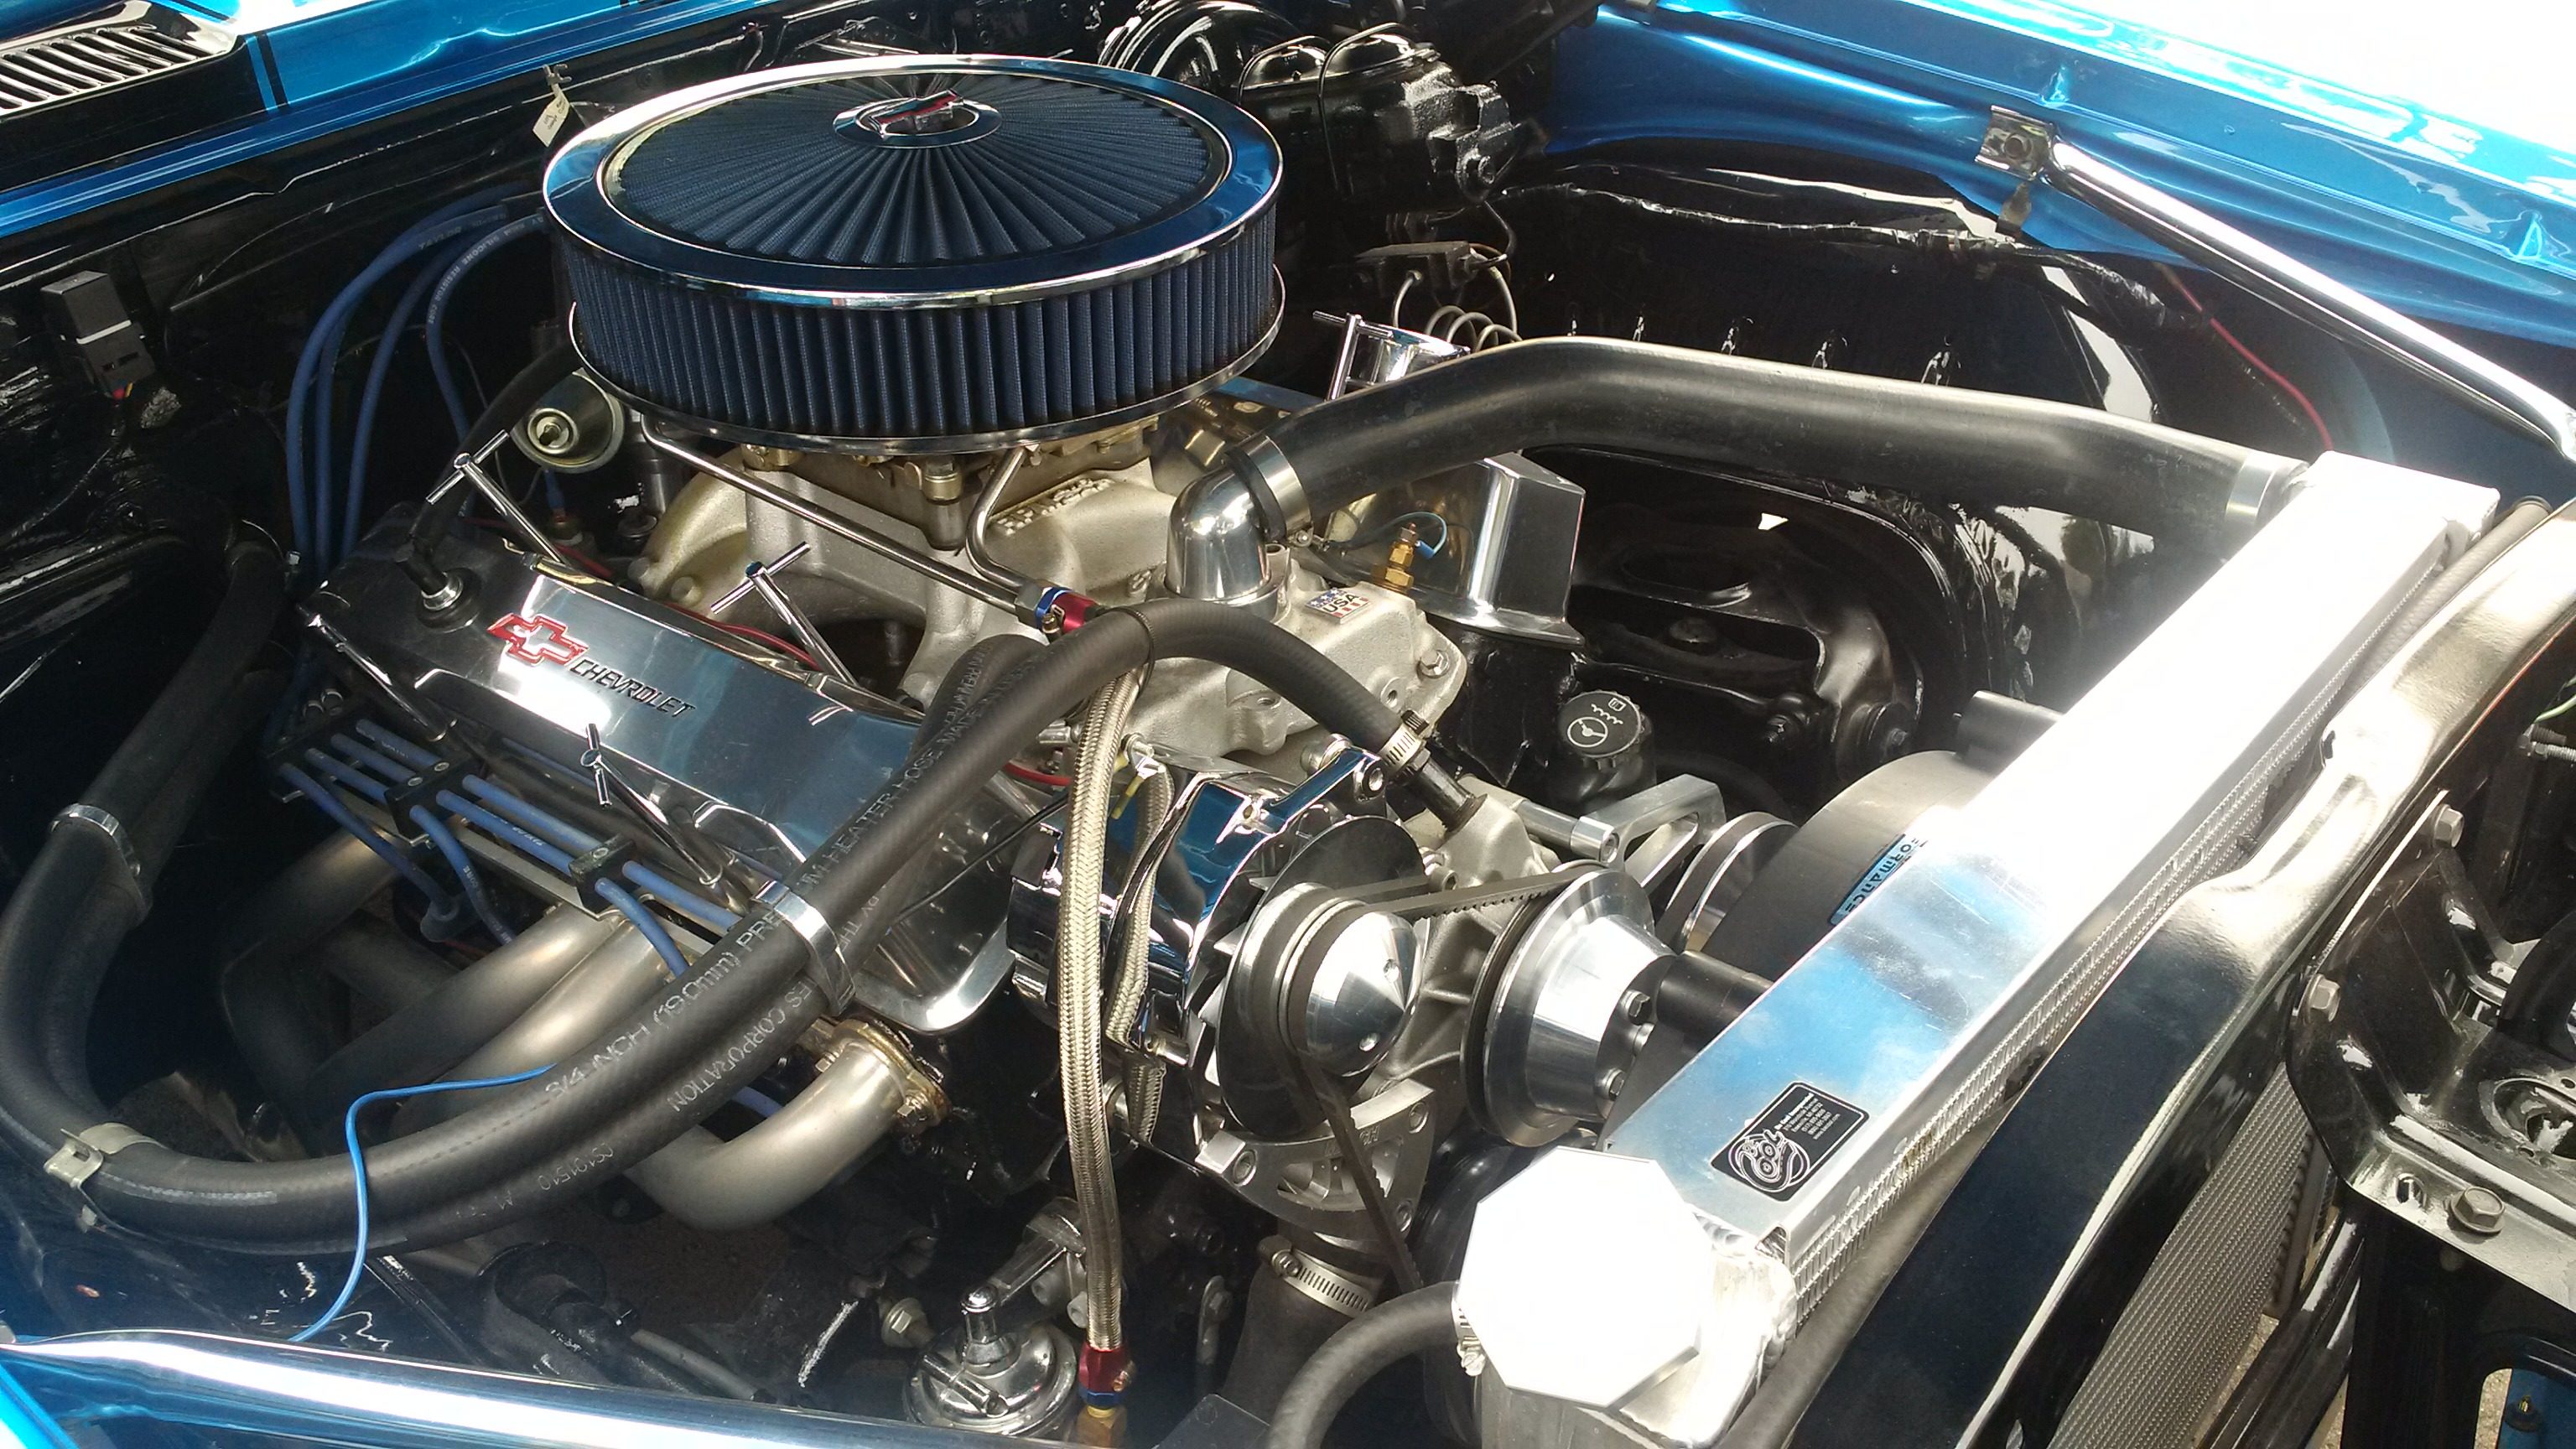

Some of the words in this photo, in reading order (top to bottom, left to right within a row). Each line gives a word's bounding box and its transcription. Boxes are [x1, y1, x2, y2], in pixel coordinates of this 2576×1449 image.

[461, 236, 501, 266] SILICONE
[1323, 594, 1359, 612] USA
[569, 658, 697, 718] CHEVROLET
[545, 1066, 586, 1098] 3/4
[592, 1022, 652, 1072] INCH
[828, 792, 893, 862] HEATER
[892, 748, 944, 793] HOSE
[667, 1006, 787, 1114] CORPORATION
